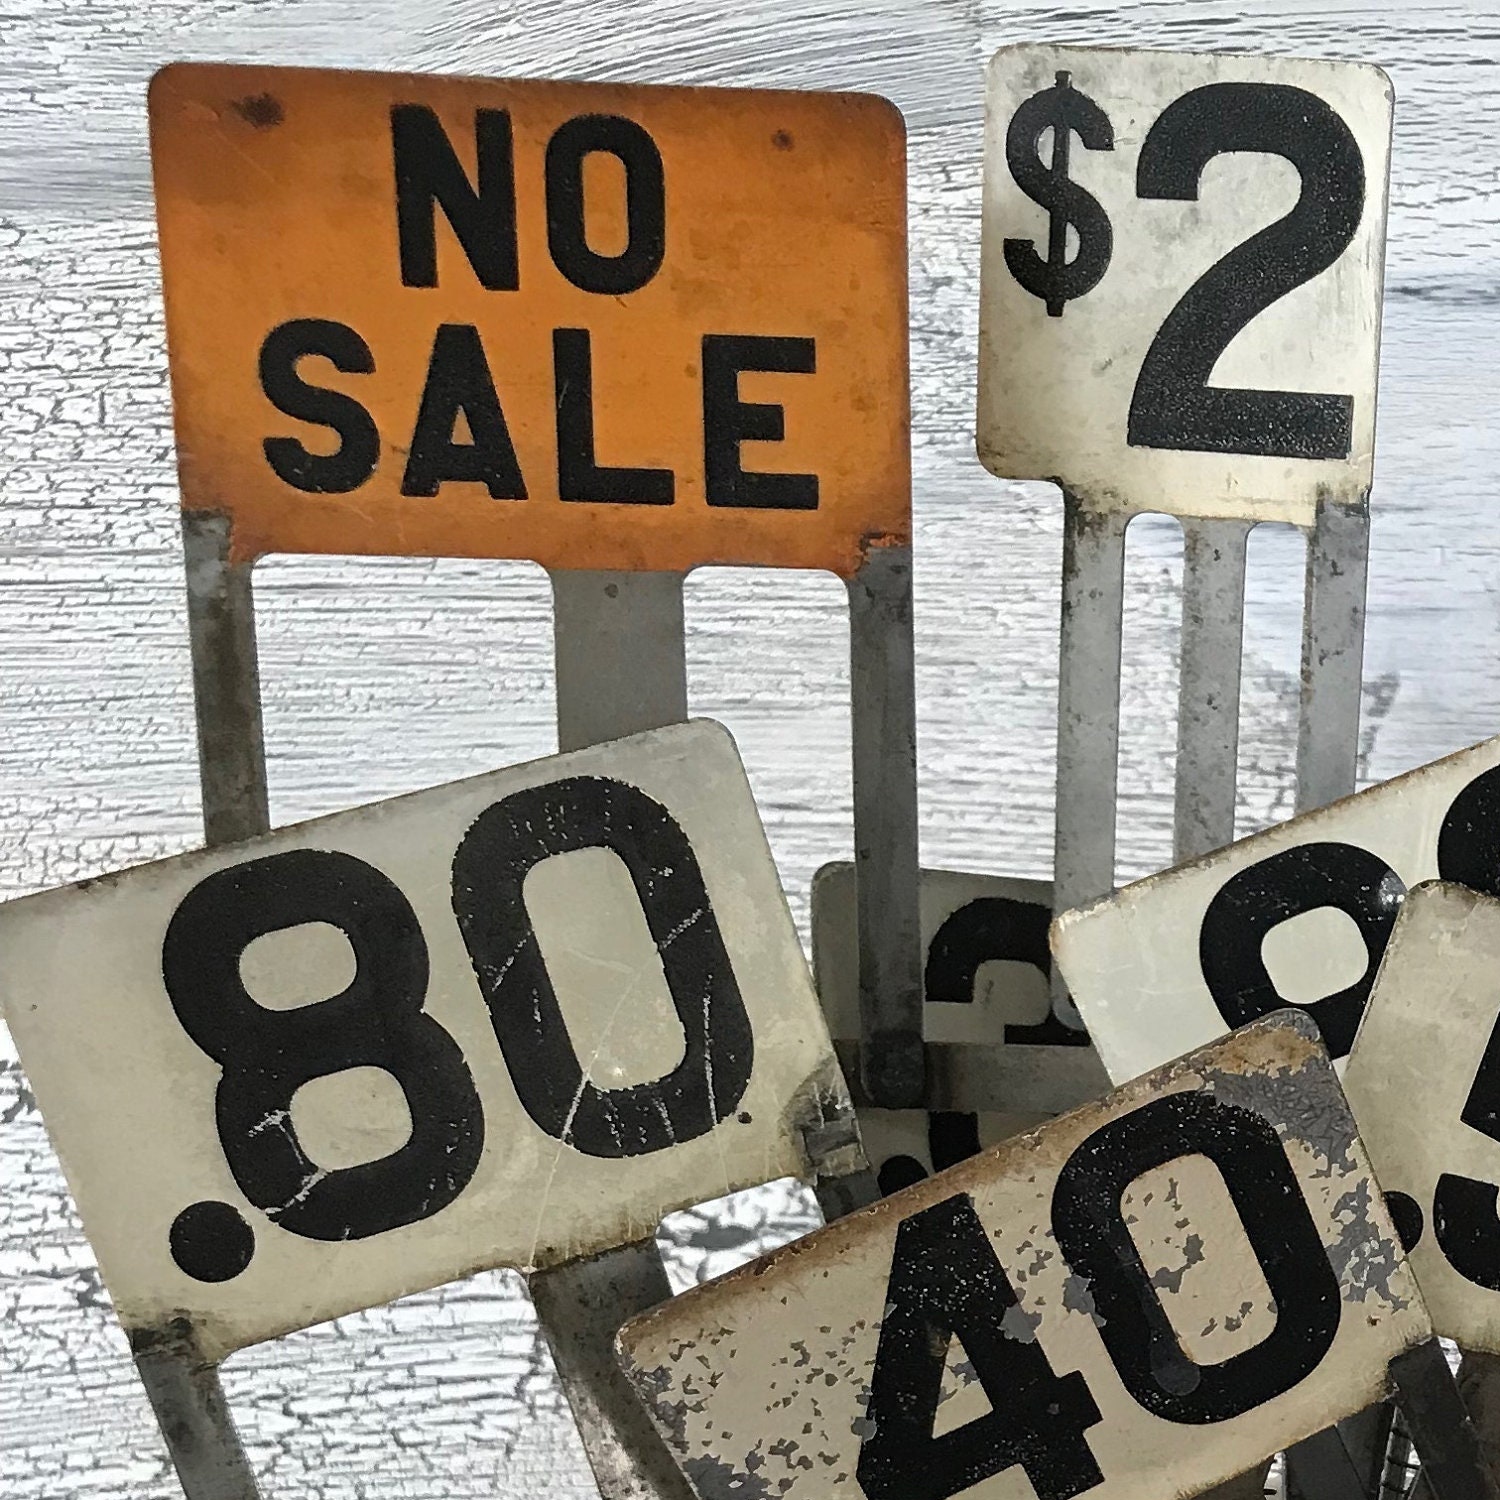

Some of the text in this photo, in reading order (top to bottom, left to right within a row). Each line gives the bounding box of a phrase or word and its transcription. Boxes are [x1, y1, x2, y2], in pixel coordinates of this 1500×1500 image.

[390, 103, 666, 295] NO
[1003, 70, 1366, 460] $2
[258, 318, 820, 511] SALE
[162, 775, 754, 1283] .80
